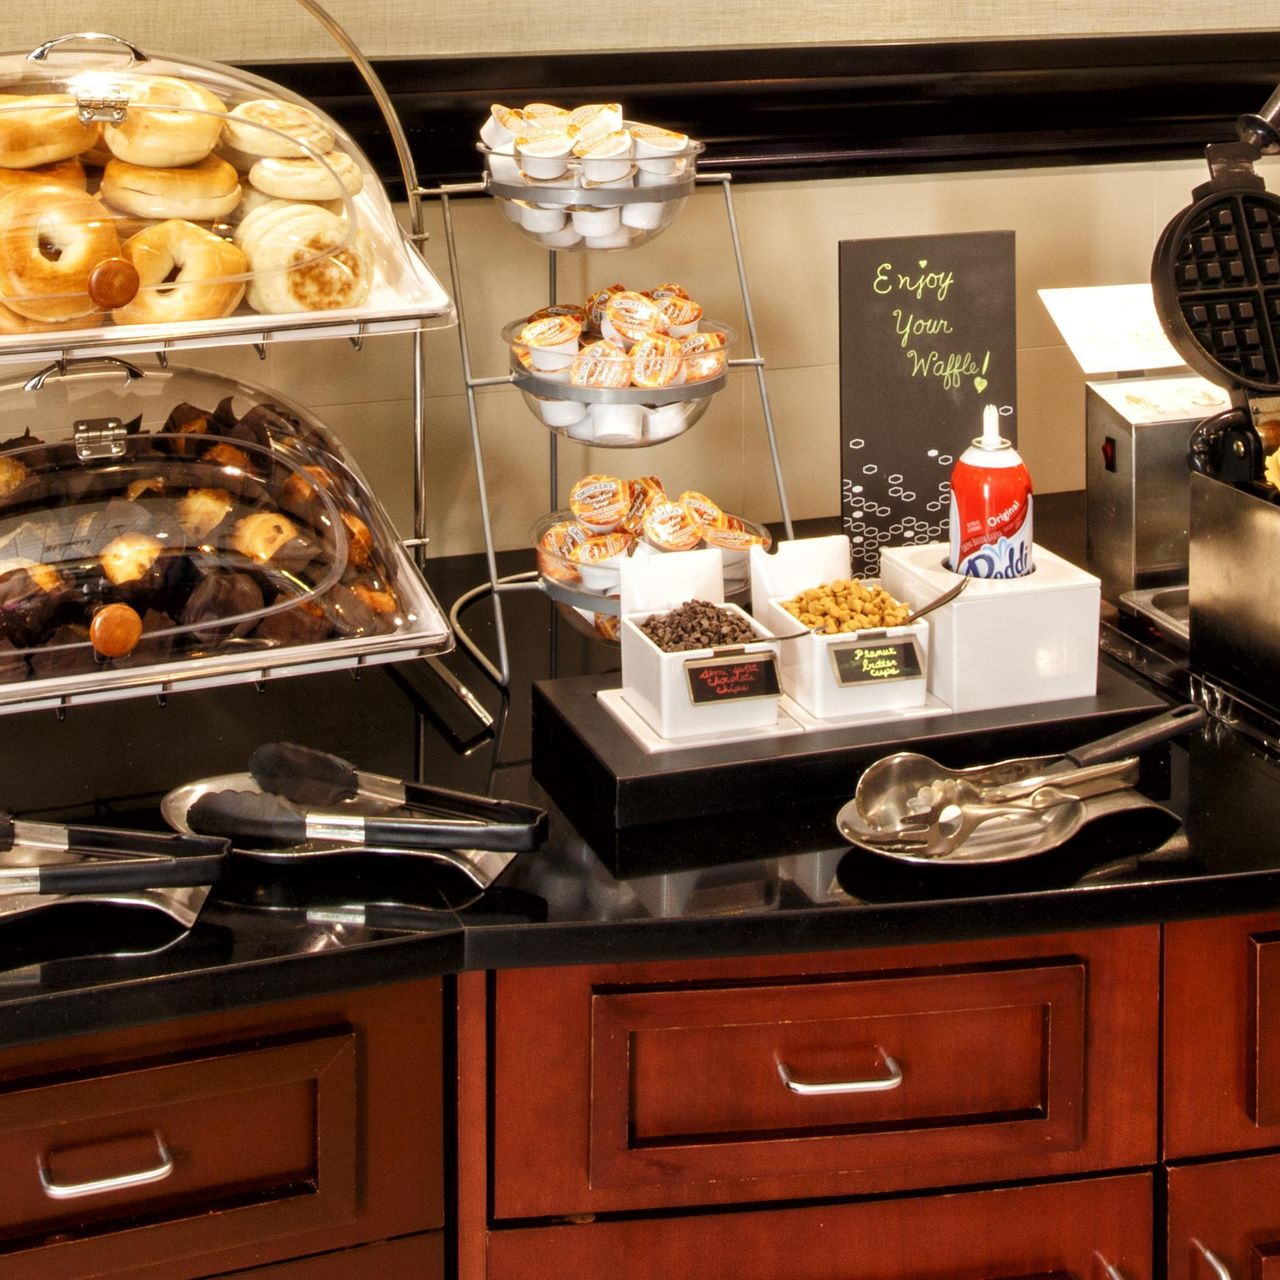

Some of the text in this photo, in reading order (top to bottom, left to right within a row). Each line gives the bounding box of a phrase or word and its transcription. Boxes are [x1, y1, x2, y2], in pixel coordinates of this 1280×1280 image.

[873, 260, 954, 301] Enjoy
[892, 308, 954, 348] Your
[906, 349, 991, 391] Waffle!
[986, 499, 1020, 527] Original
